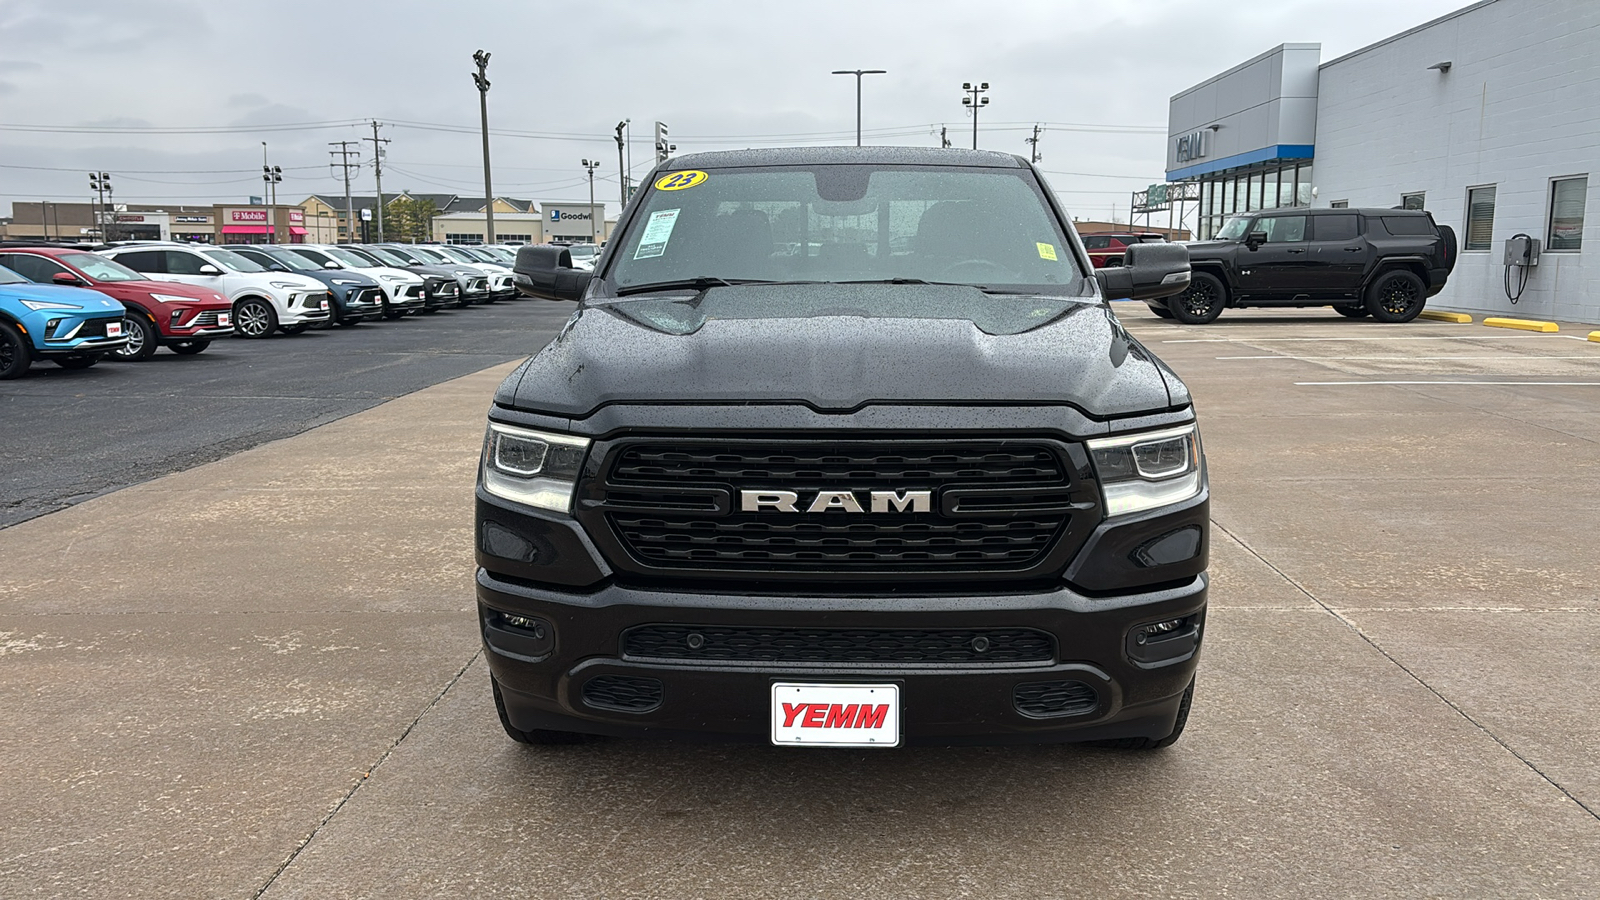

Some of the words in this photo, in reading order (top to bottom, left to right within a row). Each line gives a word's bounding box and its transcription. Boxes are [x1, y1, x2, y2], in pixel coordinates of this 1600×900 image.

[664, 173, 697, 188] 23
[561, 212, 592, 221] Goodwi
[740, 489, 932, 513] RAM
[781, 702, 890, 729] YEMM
